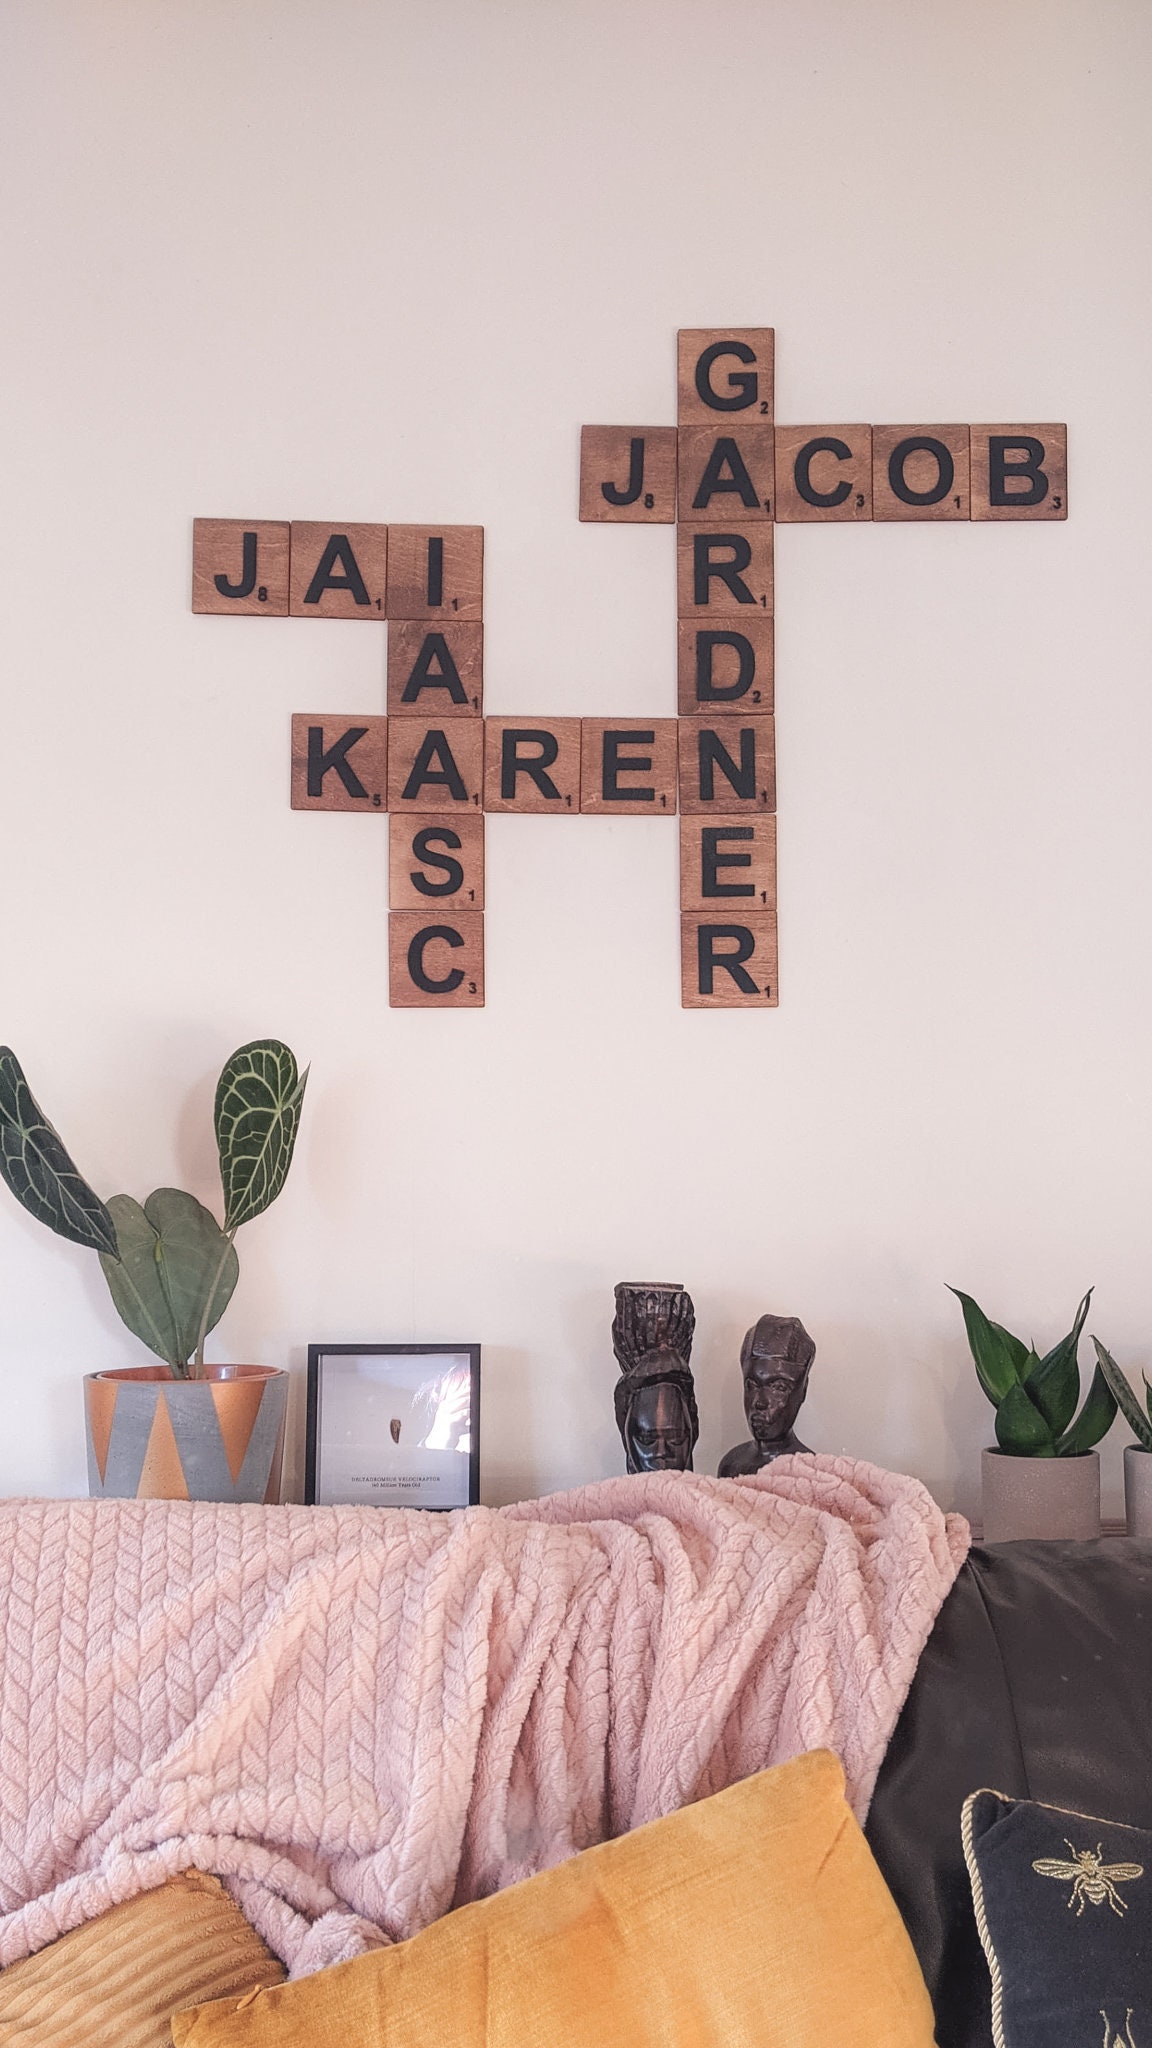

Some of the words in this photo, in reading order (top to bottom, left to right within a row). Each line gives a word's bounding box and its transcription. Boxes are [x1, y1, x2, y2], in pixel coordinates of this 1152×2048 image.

[601, 436, 1049, 509] JACOB
[213, 531, 444, 607] JAI
[306, 727, 757, 802] KAREN
